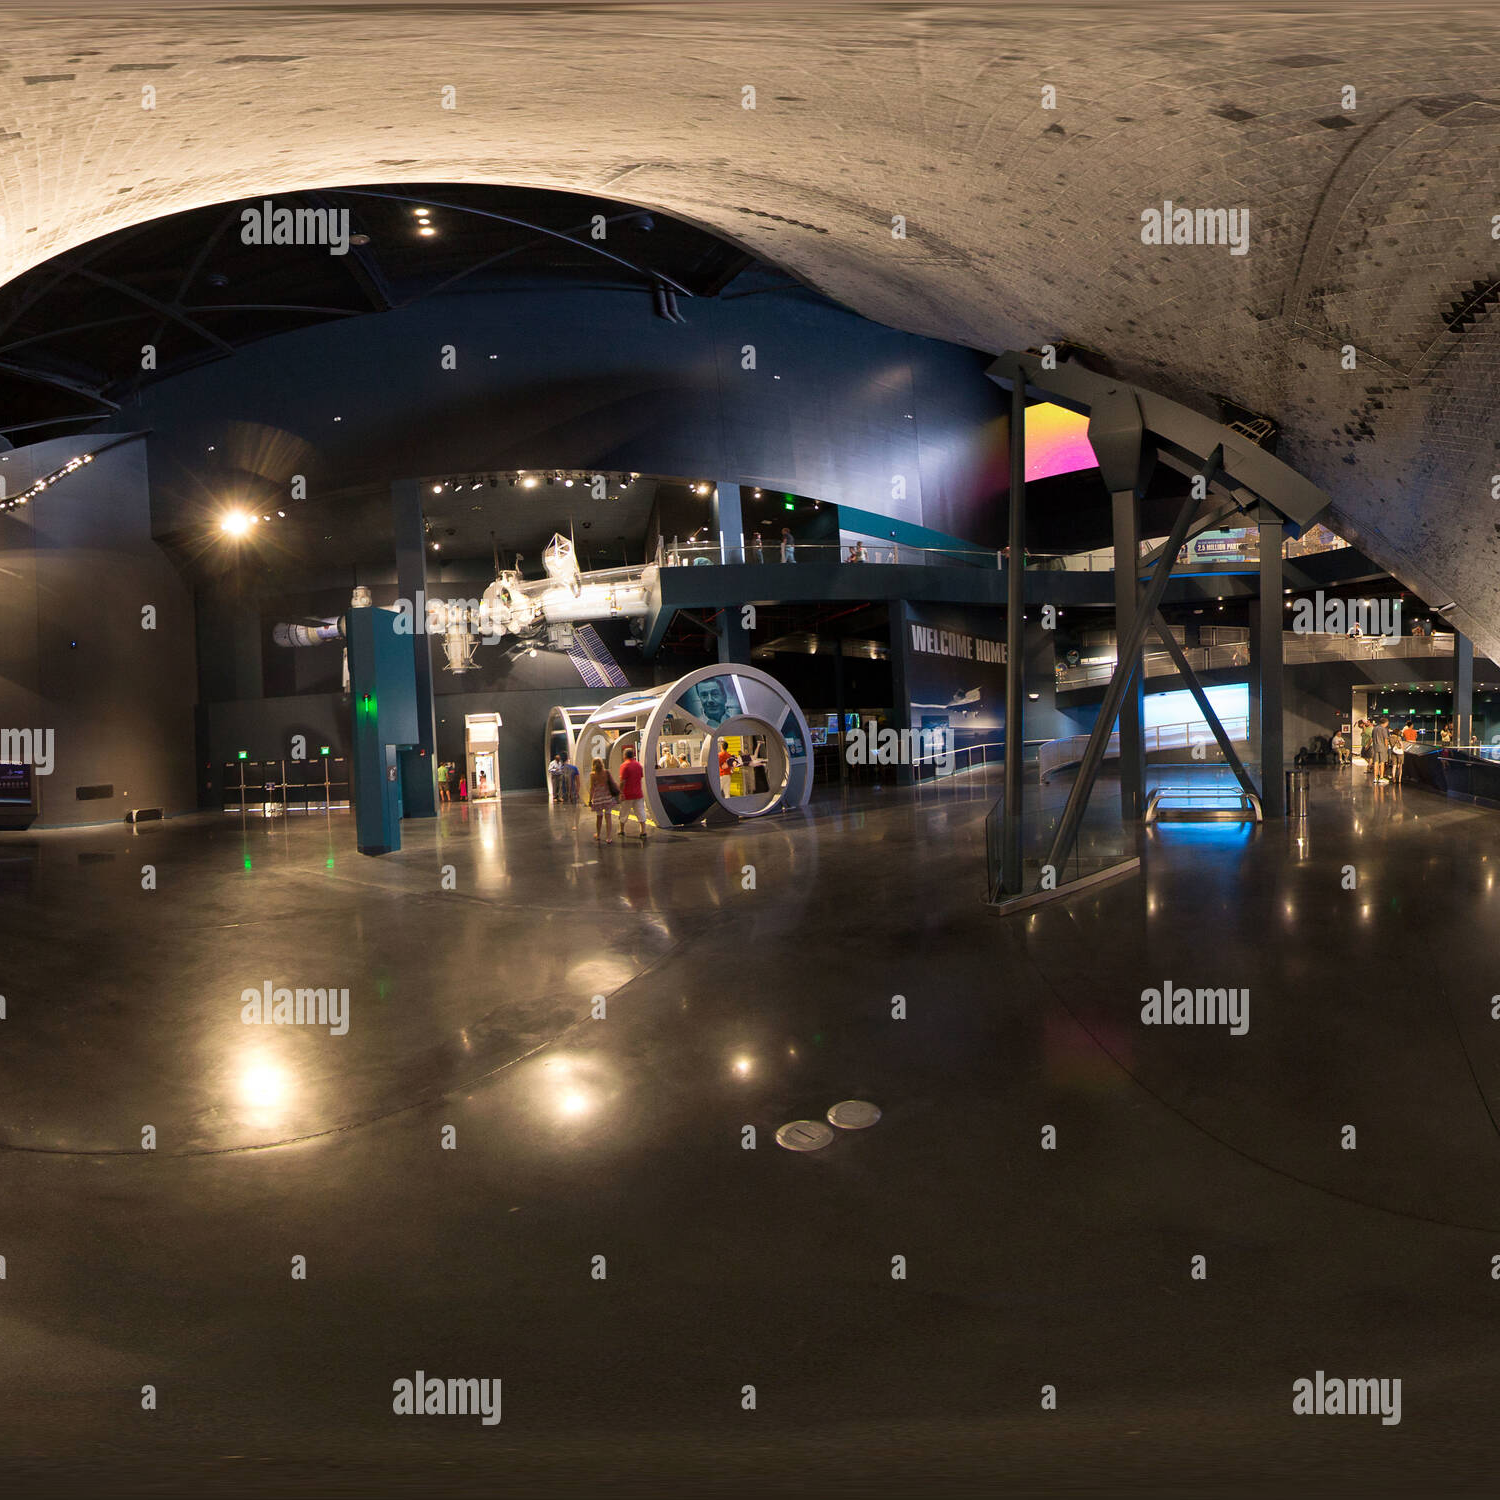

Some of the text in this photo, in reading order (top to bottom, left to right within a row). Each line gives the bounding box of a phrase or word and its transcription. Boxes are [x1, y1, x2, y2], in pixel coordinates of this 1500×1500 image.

[1206, 543, 1226, 551] MILLION
[911, 624, 1008, 664] WELCOME HOME
